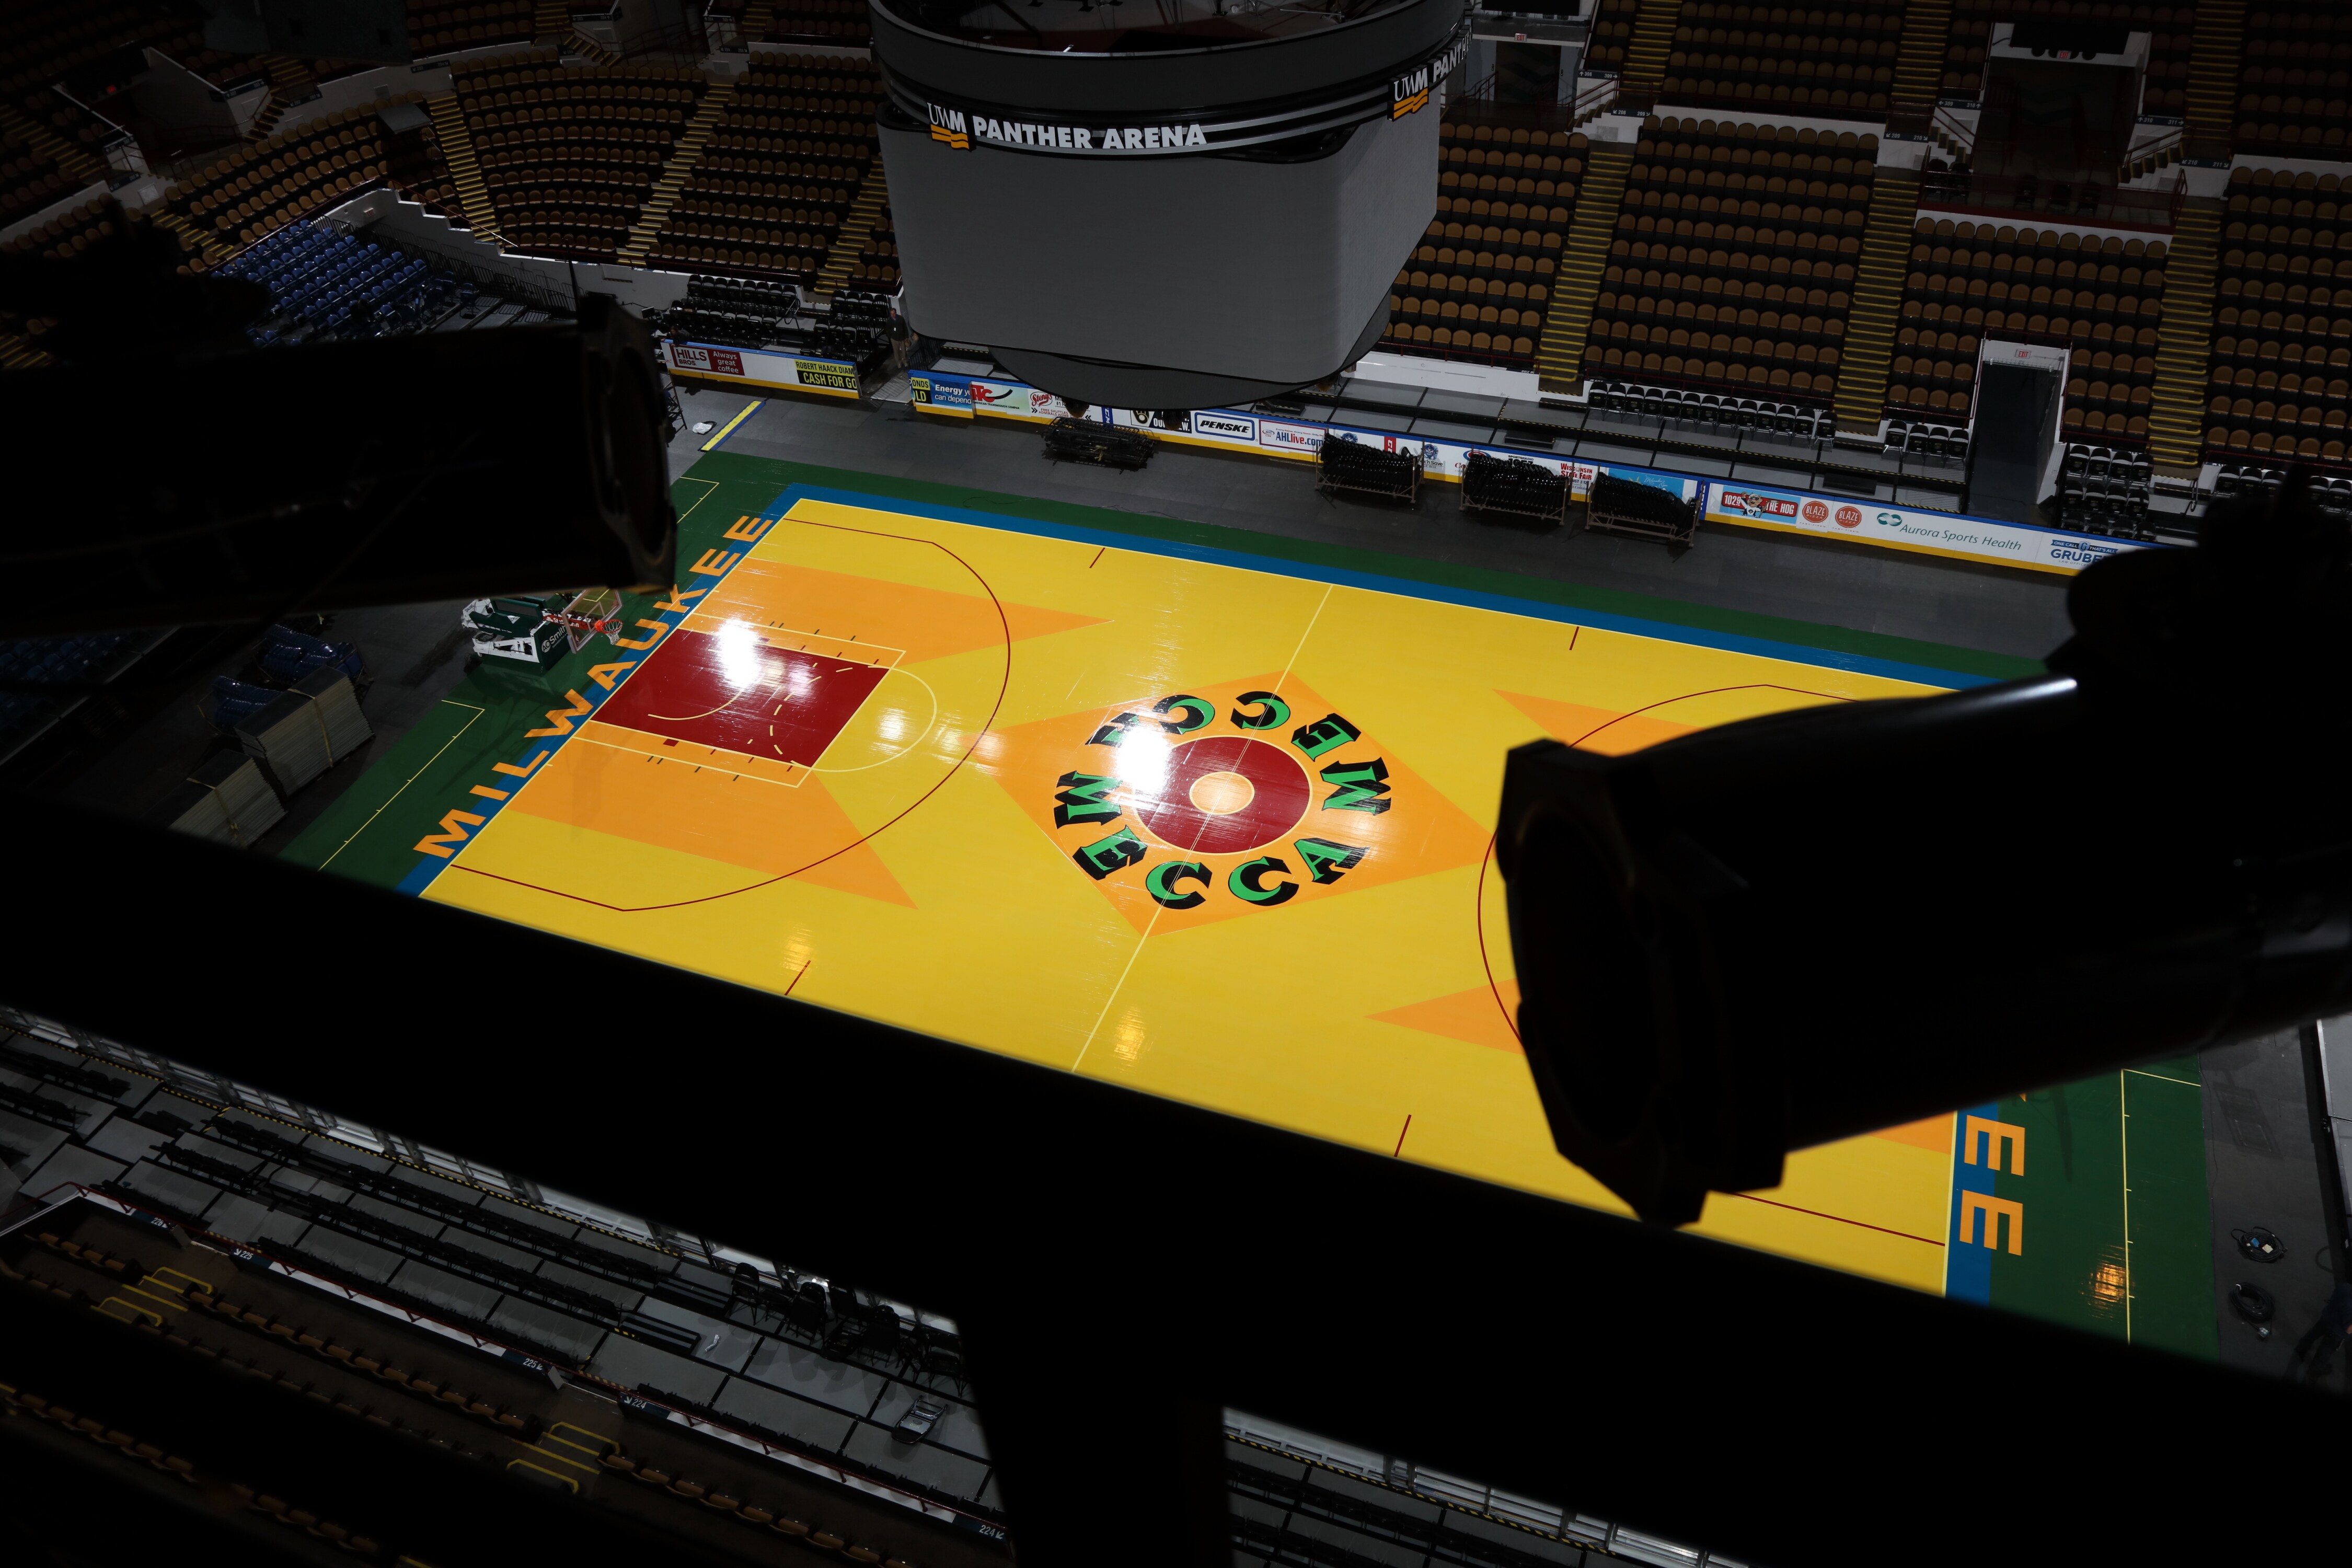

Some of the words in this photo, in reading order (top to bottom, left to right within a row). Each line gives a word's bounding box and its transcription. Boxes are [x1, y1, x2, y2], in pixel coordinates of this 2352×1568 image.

[1393, 67, 1428, 101] UWM
[927, 102, 967, 133] UWM
[972, 115, 1094, 149] PANTHER
[1102, 124, 1207, 149] ARENA
[676, 349, 707, 361] HILLS
[713, 351, 737, 360] Always
[796, 361, 816, 371] ROBERT
[818, 364, 838, 373] HAACK
[803, 372, 827, 385] CASH
[827, 375, 844, 388] FOR
[912, 379, 929, 388] ONDS
[913, 390, 926, 402] LD
[935, 384, 963, 396] Energy
[1200, 420, 1250, 433] PENSKE
[1276, 431, 1323, 447] AHLlive.com
[1767, 502, 1778, 512] THE
[1780, 503, 1794, 515] HOG
[1806, 505, 1826, 516] BLAZE
[1839, 511, 1859, 522] BLAZE
[1900, 524, 1940, 538] Aurora
[1942, 530, 1978, 544] Sports
[1982, 536, 2022, 551] Health
[2051, 549, 2104, 563] GRUBE
[549, 625, 566, 644] Smith
[413, 515, 774, 859] MILWAUKEE
[1054, 770, 1370, 910] MECCA
[151, 1217, 163, 1227] 226
[239, 1250, 254, 1260] 225
[523, 1358, 538, 1369] 225
[631, 1398, 648, 1409] 224
[979, 1524, 996, 1537] 224
